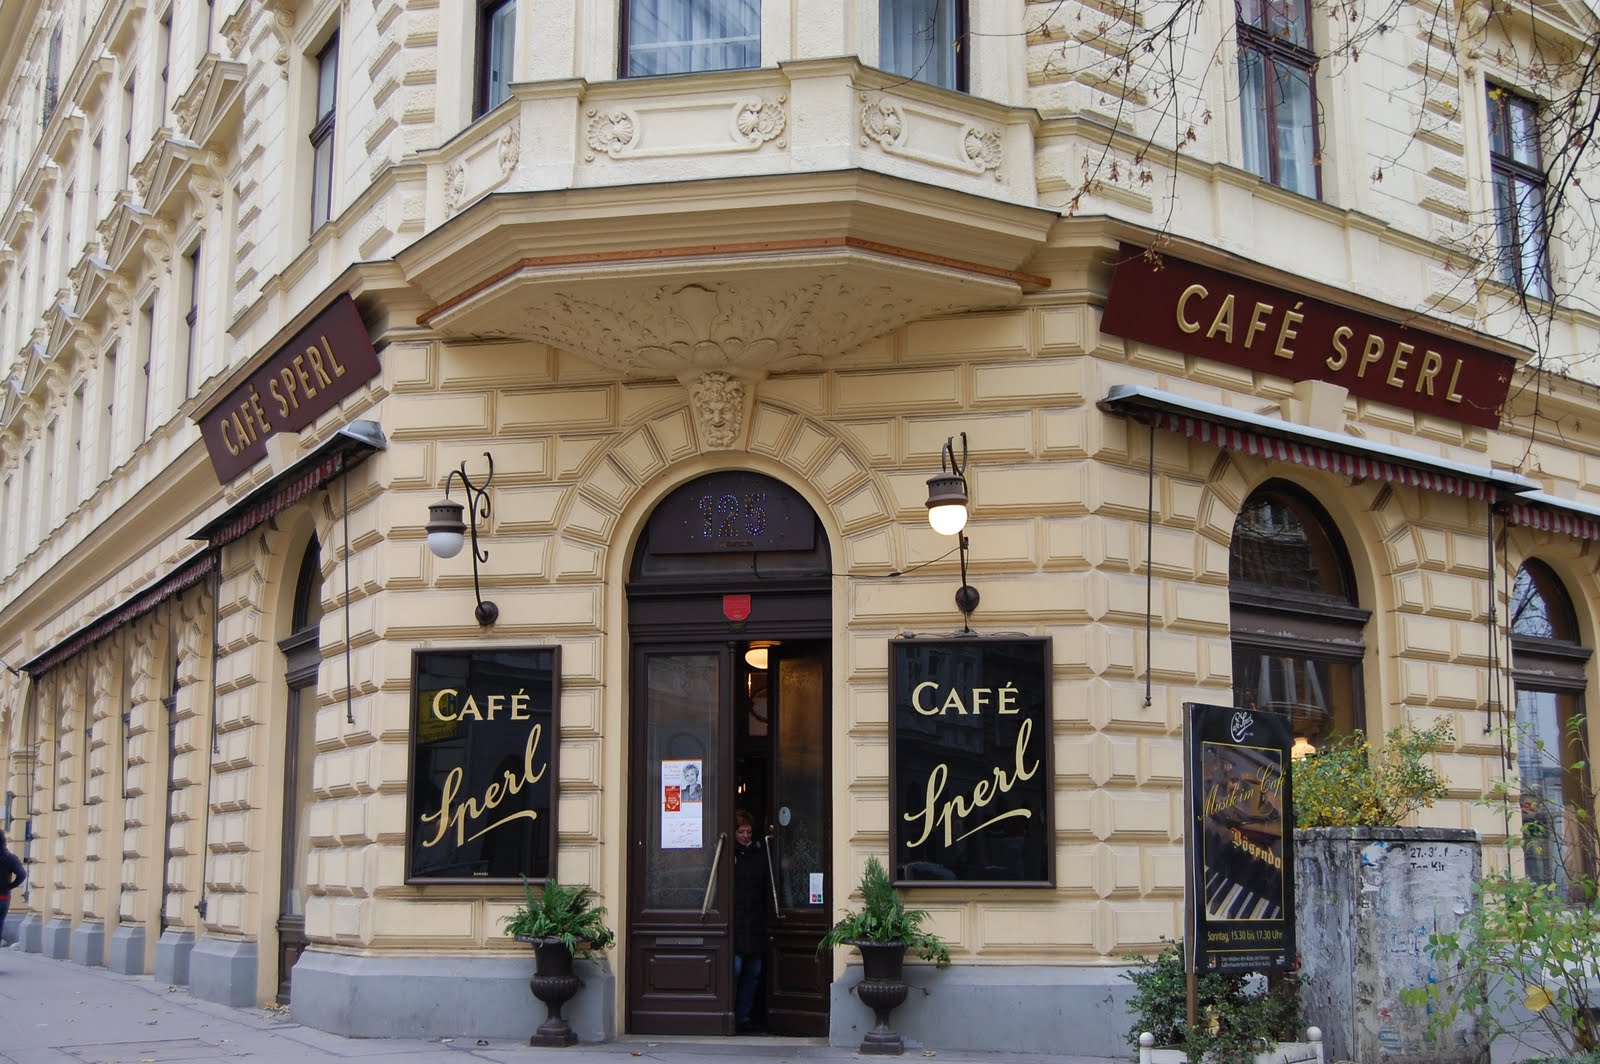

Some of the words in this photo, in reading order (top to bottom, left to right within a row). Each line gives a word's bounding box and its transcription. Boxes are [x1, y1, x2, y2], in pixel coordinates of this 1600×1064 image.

[220, 383, 272, 456] CAFÉ
[270, 335, 346, 419] SPERL
[1176, 283, 1305, 360] CAFÉ
[1326, 325, 1466, 404] SPERL
[699, 493, 767, 538] 125
[421, 723, 547, 848] Sperl
[904, 717, 1040, 848] Sperl
[1197, 784, 1238, 821] Musik
[1239, 788, 1255, 802] im
[1256, 762, 1287, 798] Café
[1207, 931, 1229, 943] Sonntag,
[1231, 930, 1246, 940] 15.30
[1246, 930, 1255, 940] bis
[1256, 930, 1271, 940] 17.30
[1271, 930, 1283, 940] Uhr
